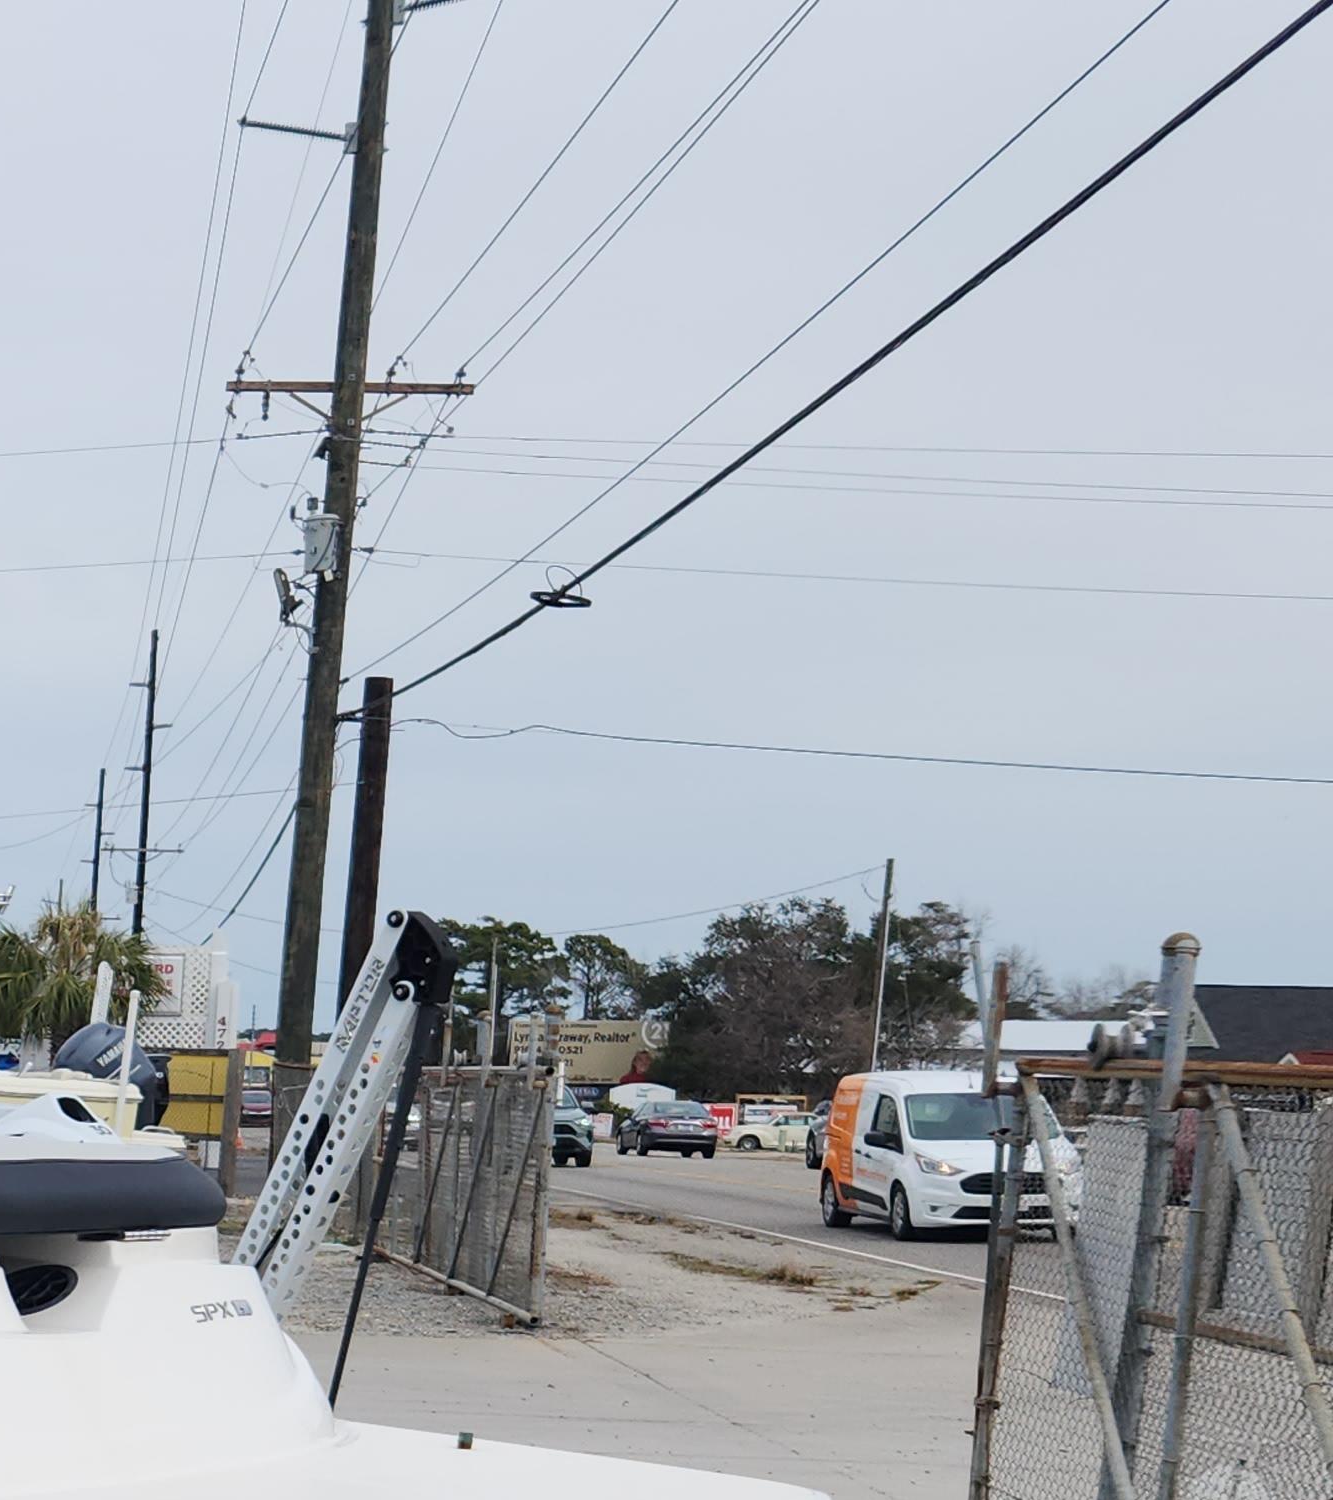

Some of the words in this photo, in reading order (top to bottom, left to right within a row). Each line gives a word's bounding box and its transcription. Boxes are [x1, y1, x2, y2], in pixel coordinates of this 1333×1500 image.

[155, 964, 174, 974] RD
[96, 1038, 126, 1067] YAMAH
[190, 1301, 234, 1323] SPX
